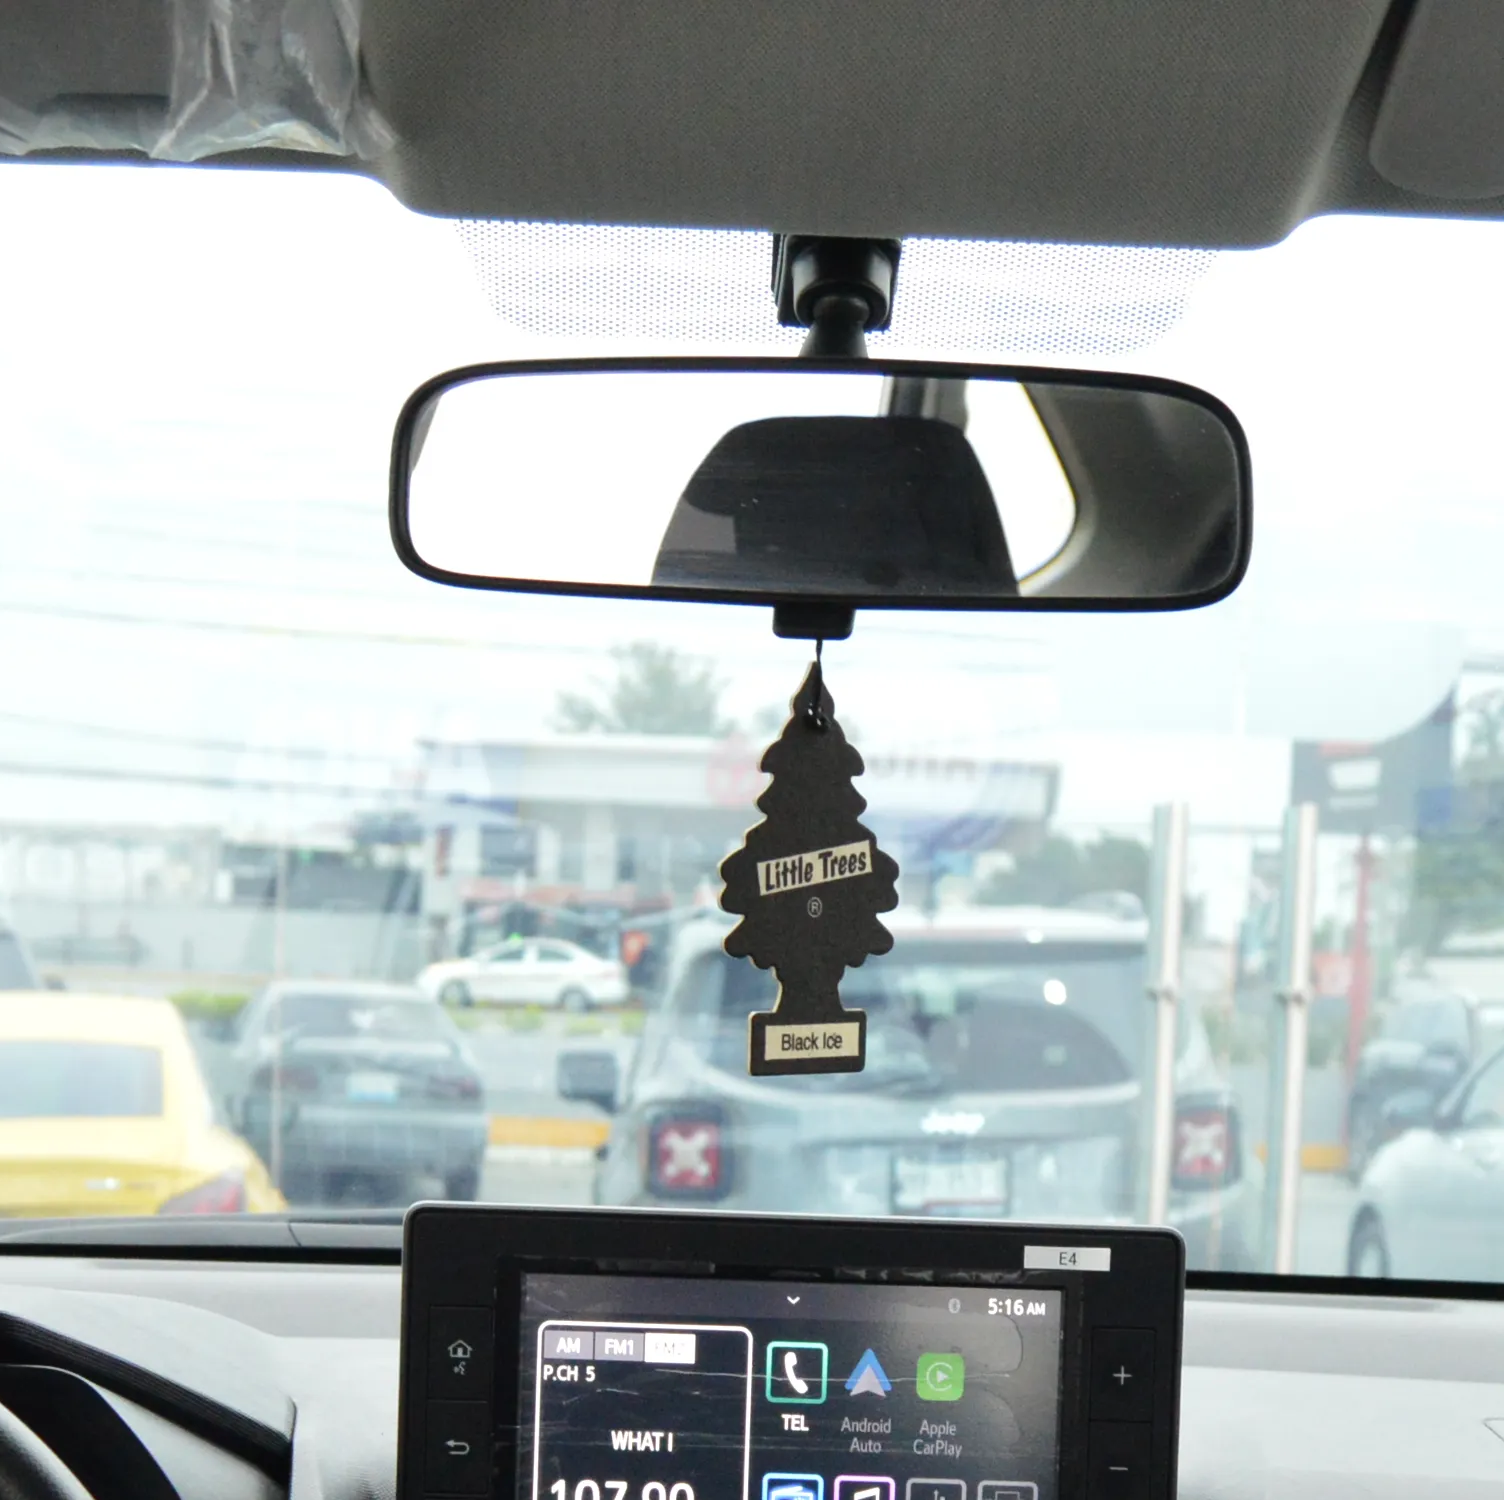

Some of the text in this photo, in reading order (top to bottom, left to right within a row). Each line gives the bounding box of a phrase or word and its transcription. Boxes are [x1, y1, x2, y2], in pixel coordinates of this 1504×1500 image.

[764, 849, 867, 892] Little Trees
[781, 1032, 843, 1052] Black Ice
[1058, 1252, 1077, 1266] E4
[988, 1298, 1046, 1316] 5:16 AM
[556, 1337, 581, 1354] AM
[605, 1338, 634, 1355] FM1
[543, 1365, 595, 1382] P.CH 5
[781, 1414, 809, 1432] TEL
[841, 1417, 891, 1434] Android
[920, 1419, 956, 1437] Apple
[611, 1430, 662, 1452] WHAT
[850, 1437, 881, 1453] Auto
[913, 1440, 962, 1458] CarPlay
